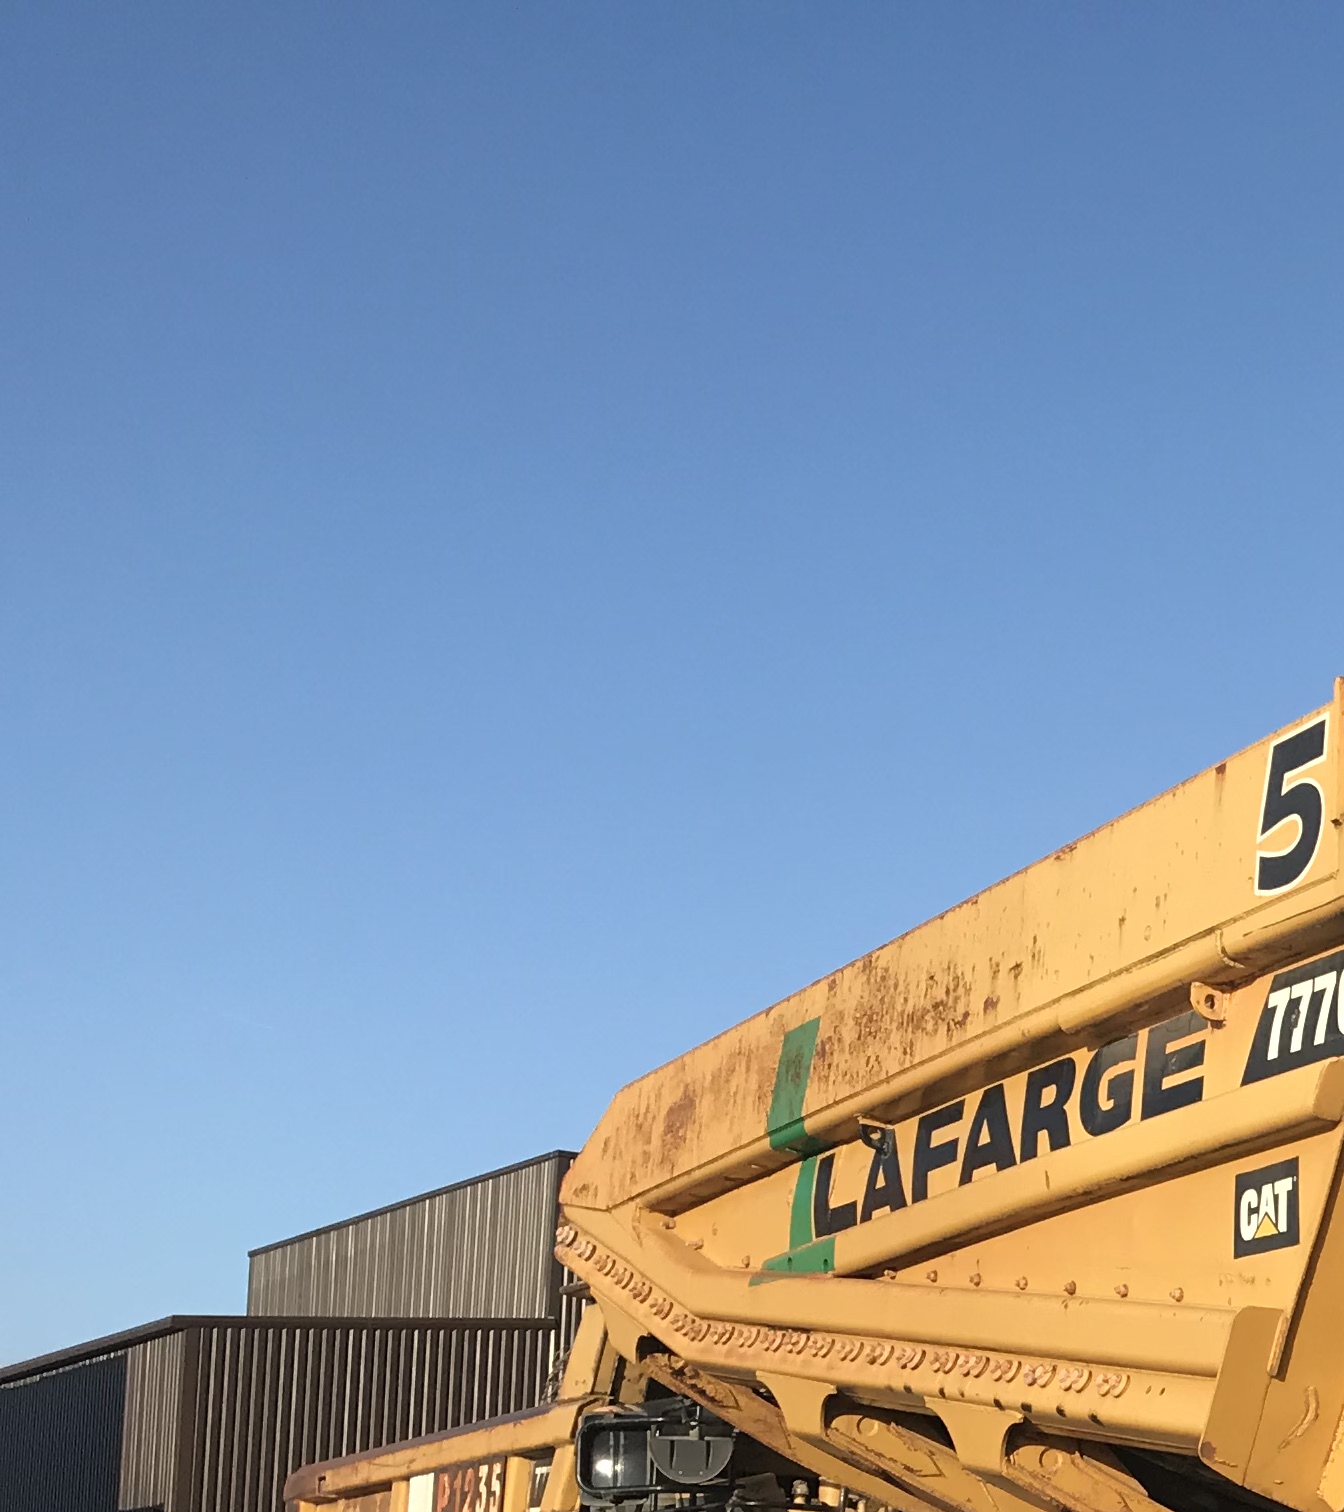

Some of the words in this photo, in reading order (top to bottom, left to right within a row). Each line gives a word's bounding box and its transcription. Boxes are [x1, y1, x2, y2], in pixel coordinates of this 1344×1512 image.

[1254, 711, 1330, 896] 5
[813, 1009, 1208, 1239] LAFARGE
[1239, 1176, 1293, 1241] CAT
